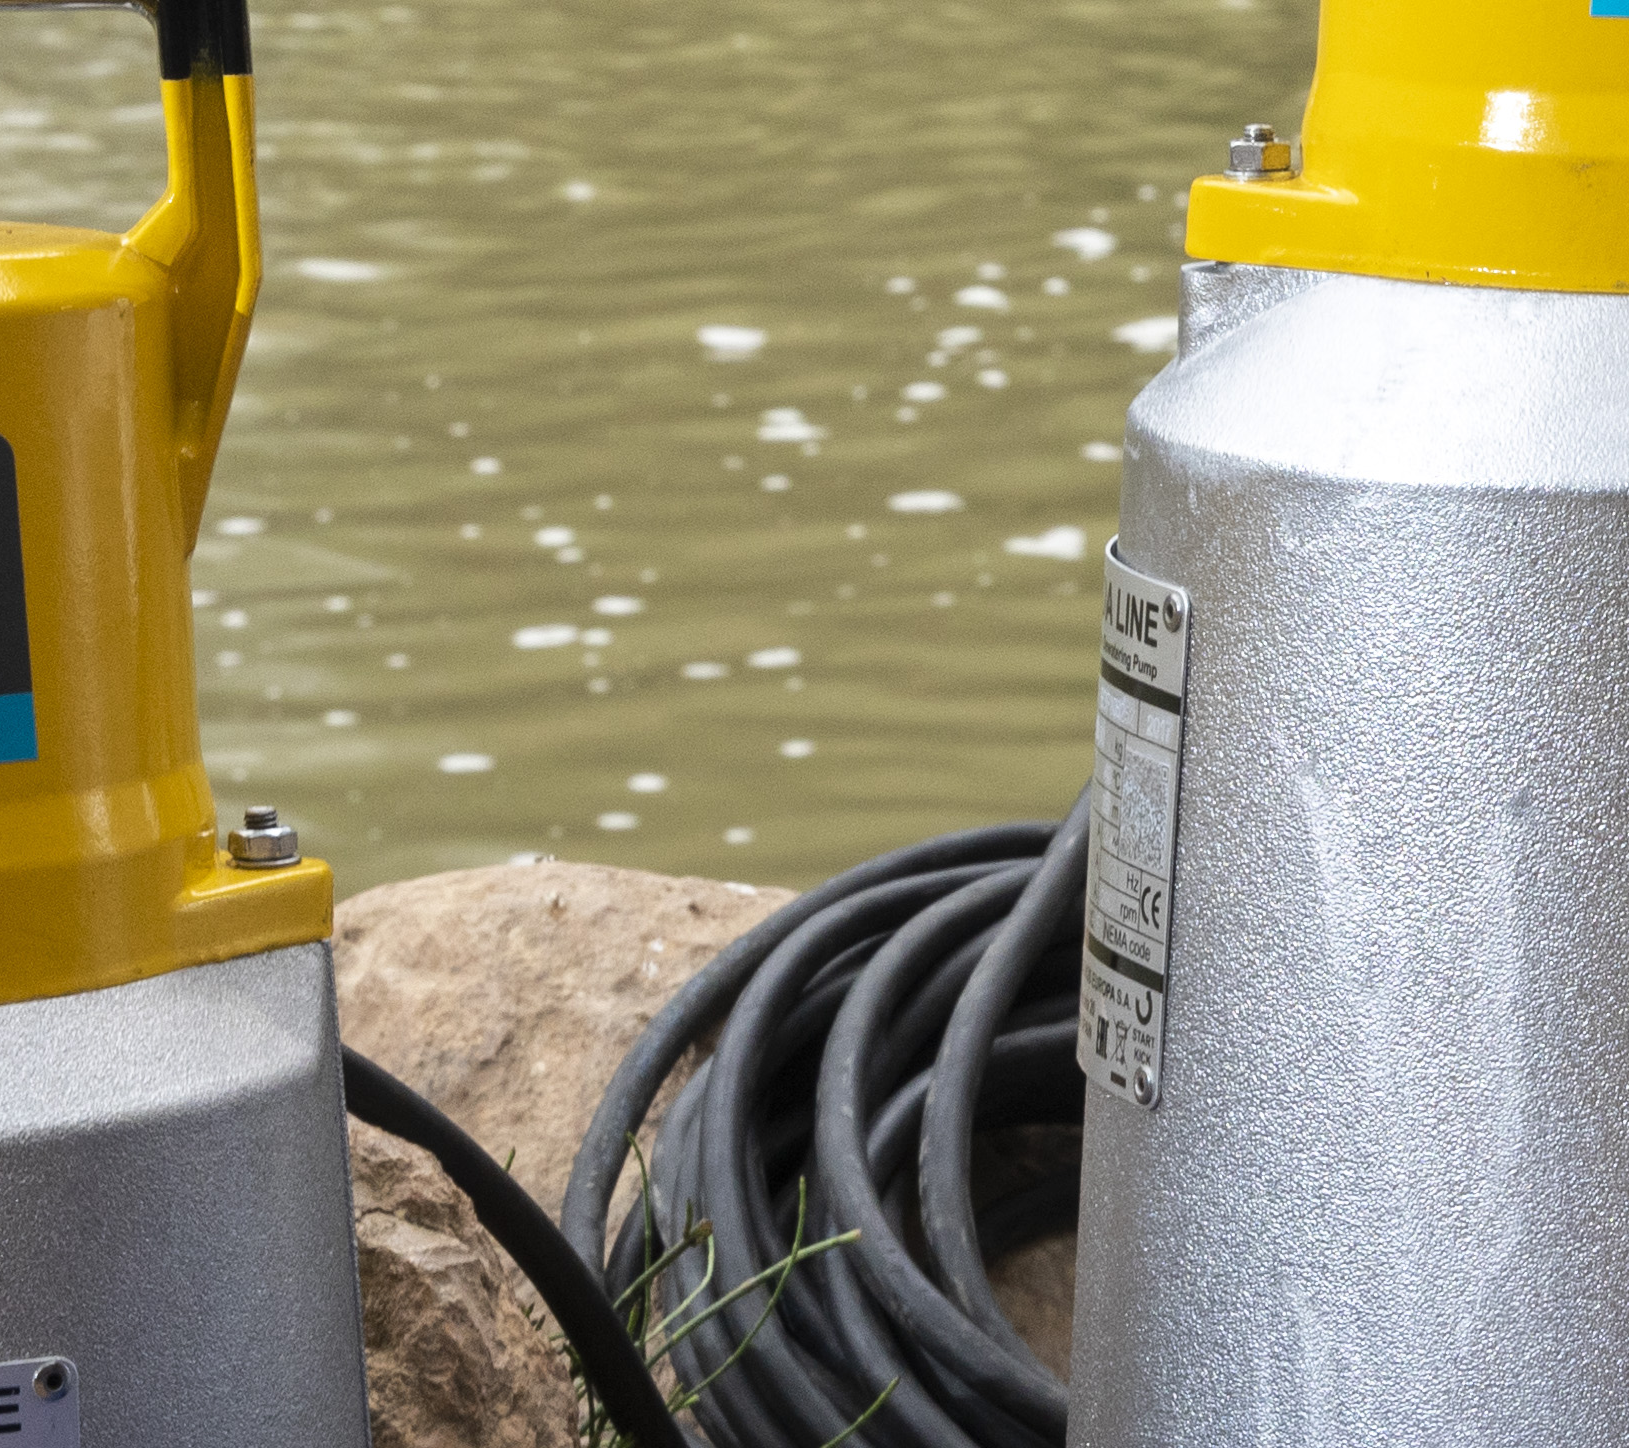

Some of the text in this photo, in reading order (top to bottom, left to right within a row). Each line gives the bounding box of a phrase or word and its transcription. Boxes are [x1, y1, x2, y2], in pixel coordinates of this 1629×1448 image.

[1115, 588, 1160, 648] LINE
[1133, 653, 1158, 681] Pump
[1126, 871, 1139, 893] Hz
[1119, 903, 1138, 924] rpm
[1129, 939, 1151, 962] code
[1132, 1028, 1155, 1049] START
[1133, 1047, 1151, 1065] KICK
